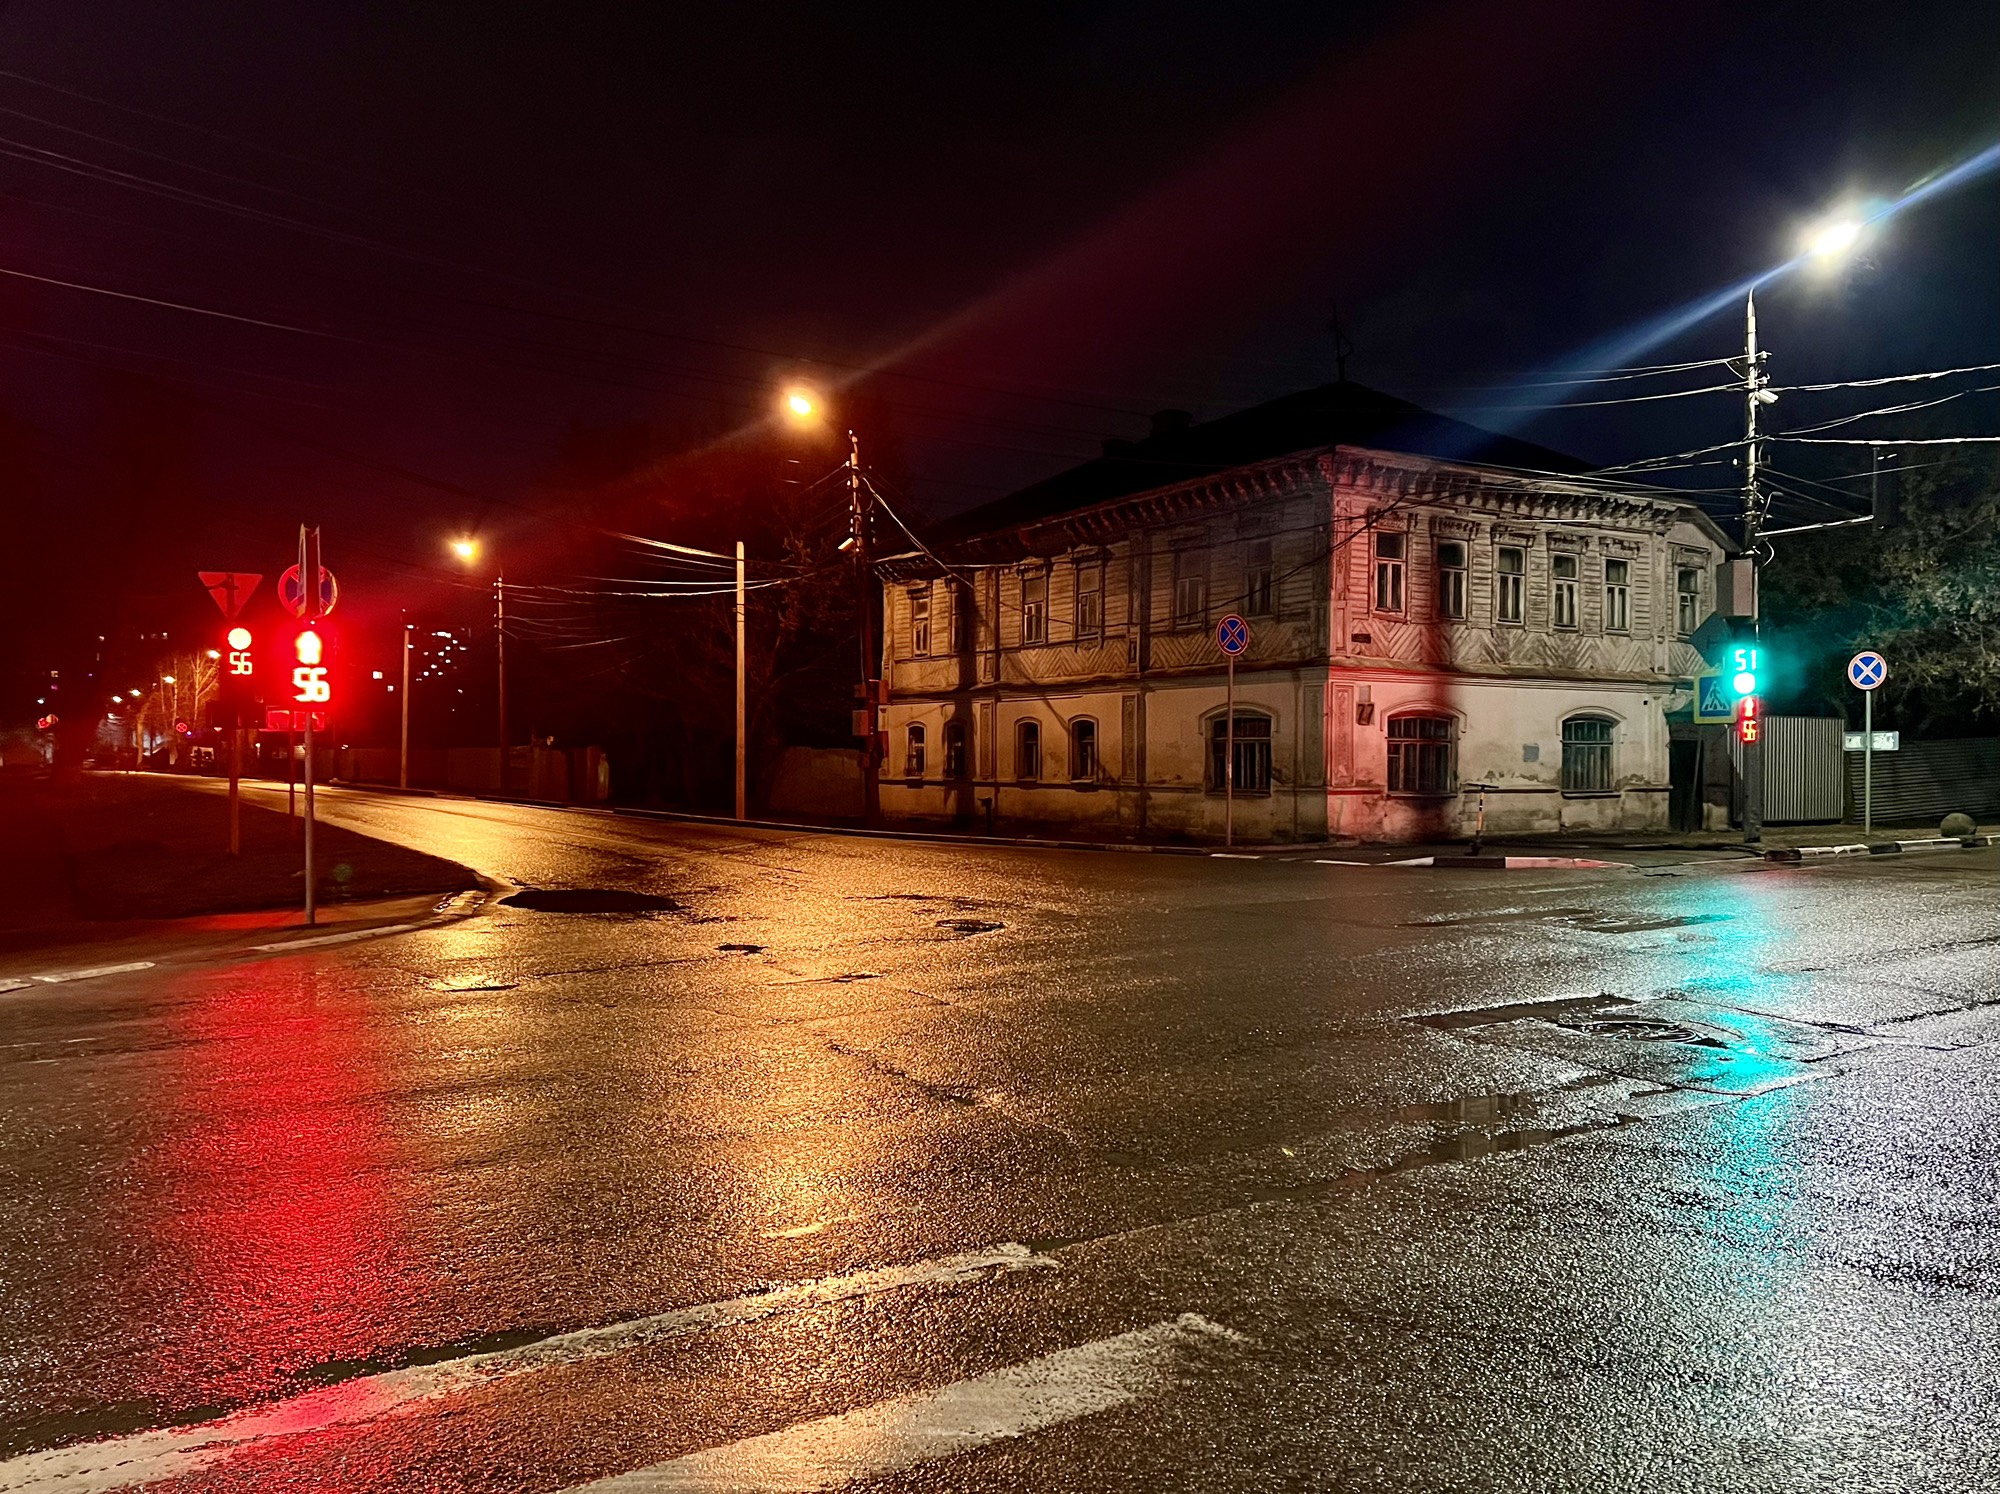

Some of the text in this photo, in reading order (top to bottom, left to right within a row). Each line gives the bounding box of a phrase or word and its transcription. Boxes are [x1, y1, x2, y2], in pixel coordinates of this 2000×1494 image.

[230, 652, 253, 675] 56
[1735, 649, 1757, 671] 51
[292, 667, 331, 704] 56
